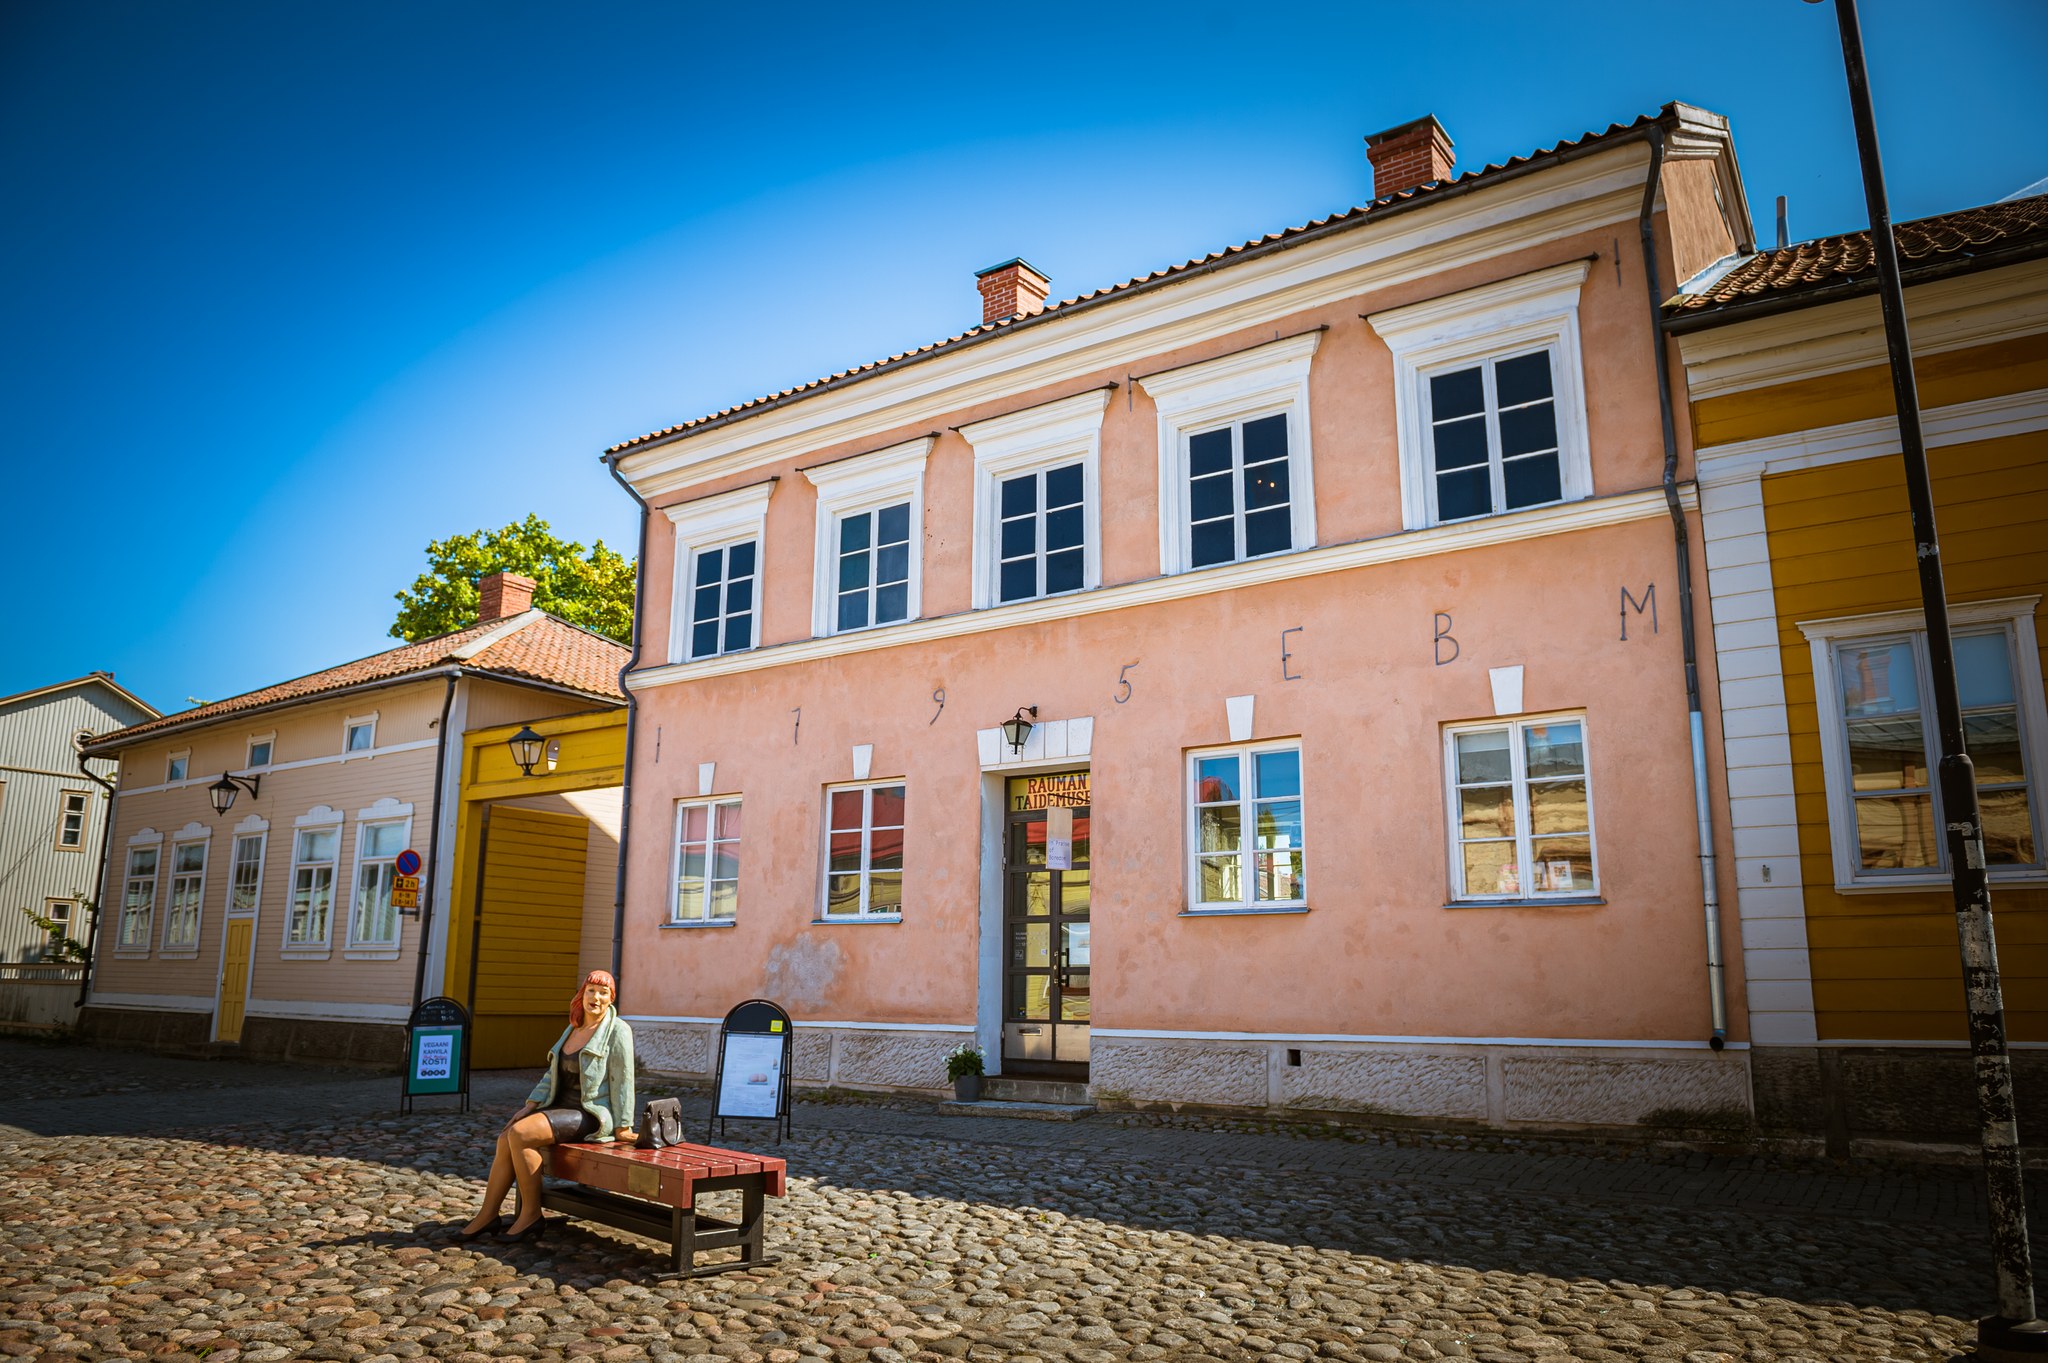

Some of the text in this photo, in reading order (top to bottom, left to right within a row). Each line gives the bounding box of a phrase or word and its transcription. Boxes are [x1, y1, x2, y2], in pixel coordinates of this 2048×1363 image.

[791, 706, 801, 746] 7
[930, 687, 946, 727] 9
[1114, 660, 1140, 704] 5
[1281, 625, 1304, 681] E
[1433, 612, 1460, 666] B
[1618, 582, 1658, 642] M
[1028, 774, 1087, 794] RAUMAN
[422, 1058, 447, 1066] KOSTI
